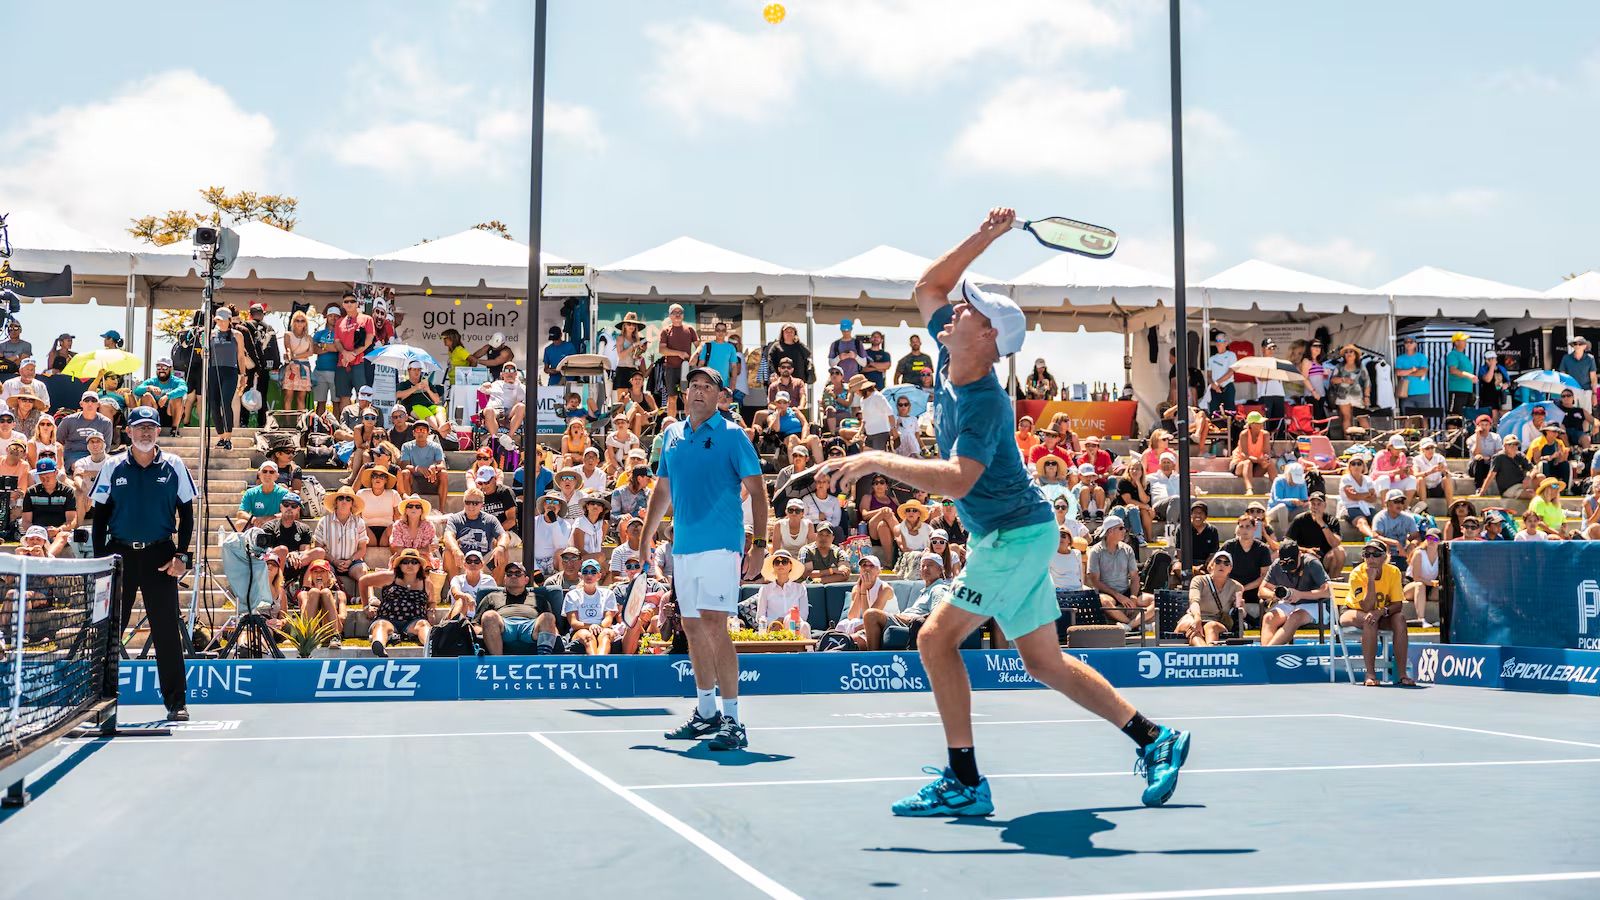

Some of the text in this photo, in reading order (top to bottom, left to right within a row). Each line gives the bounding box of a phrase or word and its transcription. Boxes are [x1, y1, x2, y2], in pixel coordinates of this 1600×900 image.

[423, 308, 519, 330] got pain?
[467, 334, 482, 343] you
[485, 334, 519, 342] cored
[1072, 419, 1106, 432] TVINE
[951, 584, 983, 607] KEYA
[1164, 652, 1239, 666] GAMMA
[475, 663, 618, 680] ELECTRUM
[851, 663, 890, 677] FOOT
[1165, 668, 1240, 678] PICKLEBALL
[1441, 654, 1485, 679] ONIX
[1513, 662, 1600, 684] PICKLEBALL
[317, 659, 419, 689] Hertz
[998, 672, 1032, 683] Hotels
[493, 682, 602, 690] PICKLEBALL
[840, 676, 923, 690] SOLUTIONS
